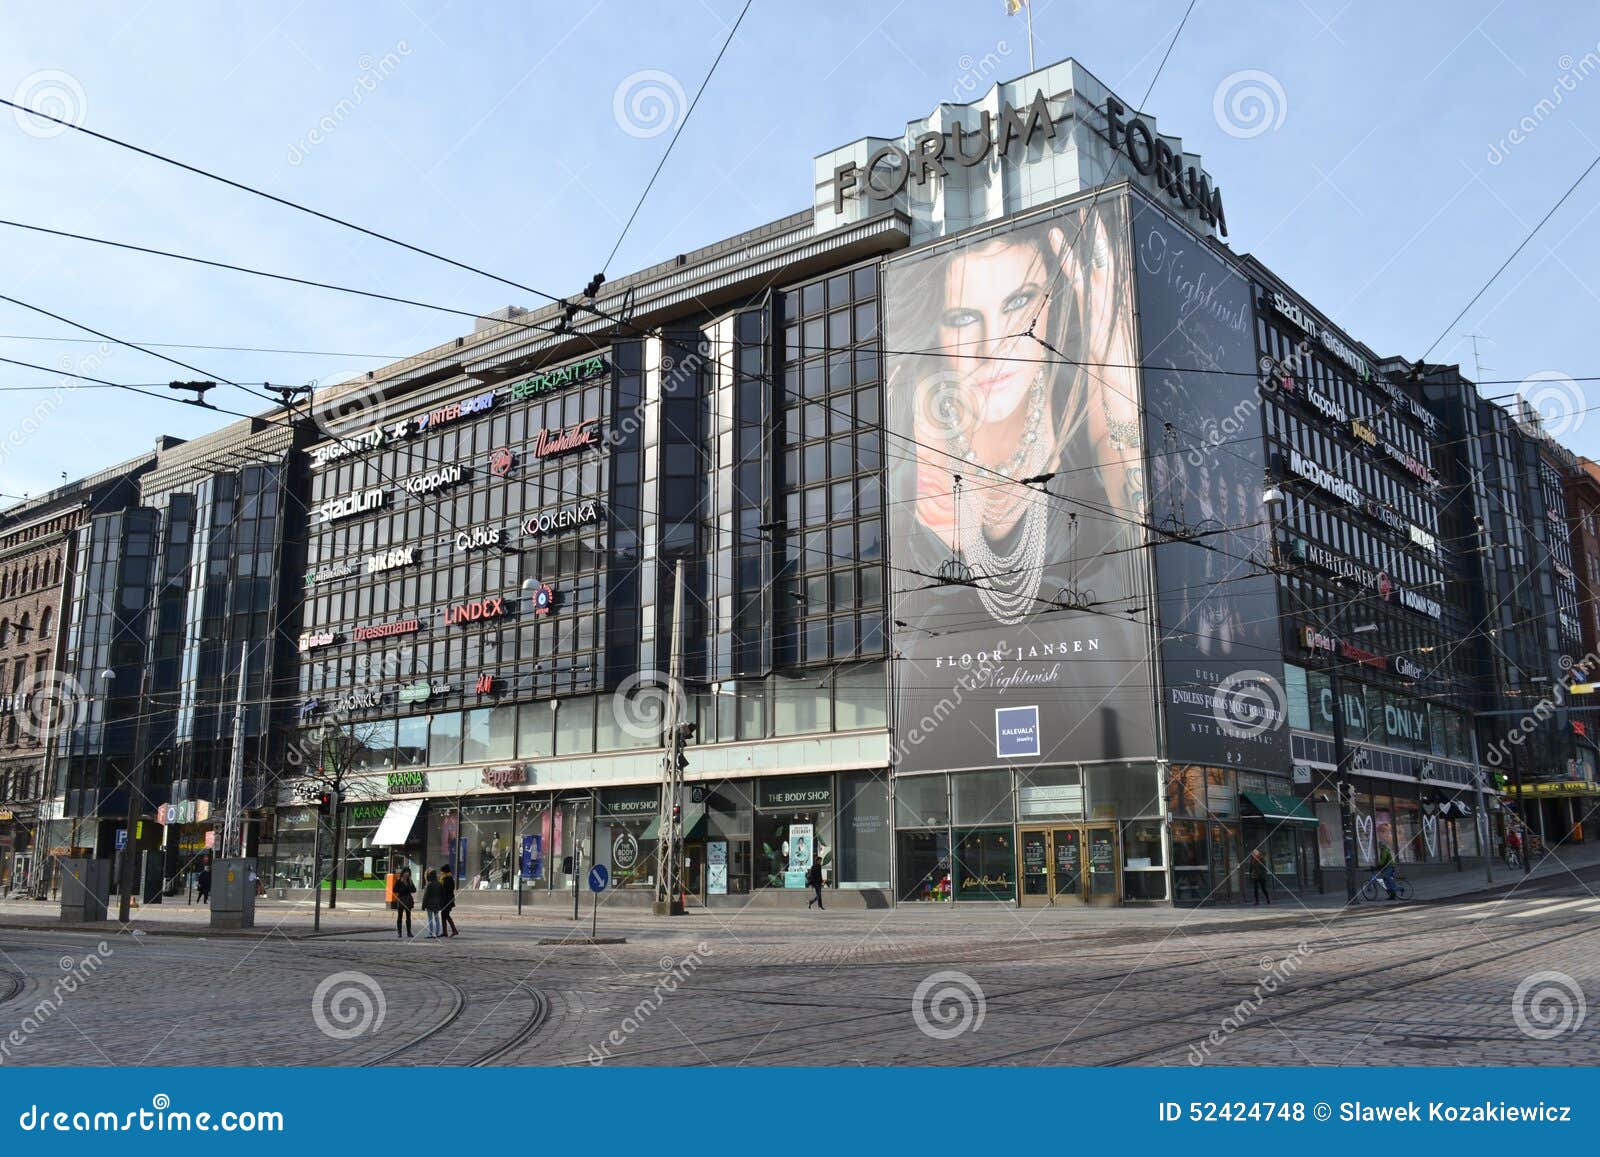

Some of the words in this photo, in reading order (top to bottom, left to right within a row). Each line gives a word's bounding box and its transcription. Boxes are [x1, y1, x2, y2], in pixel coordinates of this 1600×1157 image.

[834, 89, 1057, 214] FORUM
[1106, 97, 1228, 237] FORUM
[1141, 226, 1248, 333] Nightwish
[1274, 293, 1316, 338] stadium
[511, 357, 603, 400] RETKIAITTA
[429, 390, 495, 426] INTERSPORT
[317, 430, 374, 462] GIGANTTI
[534, 417, 598, 459] Manhattan
[406, 464, 461, 493] KappAhl
[320, 489, 384, 523] stadium
[456, 526, 500, 551] Cubus
[352, 618, 419, 641] Dressmann
[936, 650, 1002, 668] FLOOR
[1016, 638, 1099, 661] JANSEN
[1395, 656, 1422, 679] Glitter
[971, 663, 1061, 694] Nightwish
[1172, 688, 1204, 705] ENDLESS
[1205, 694, 1228, 710] FORMS
[1229, 699, 1248, 714] MOST
[1002, 727, 1034, 736] KALEVALA
[1385, 705, 1424, 741] ONLY
[386, 771, 424, 786] KAARNA
[621, 801, 640, 811] BODY
[640, 800, 657, 809] SHOP
[768, 793, 783, 802] THE
[785, 791, 806, 802] BODY
[807, 790, 830, 801] SHOP
